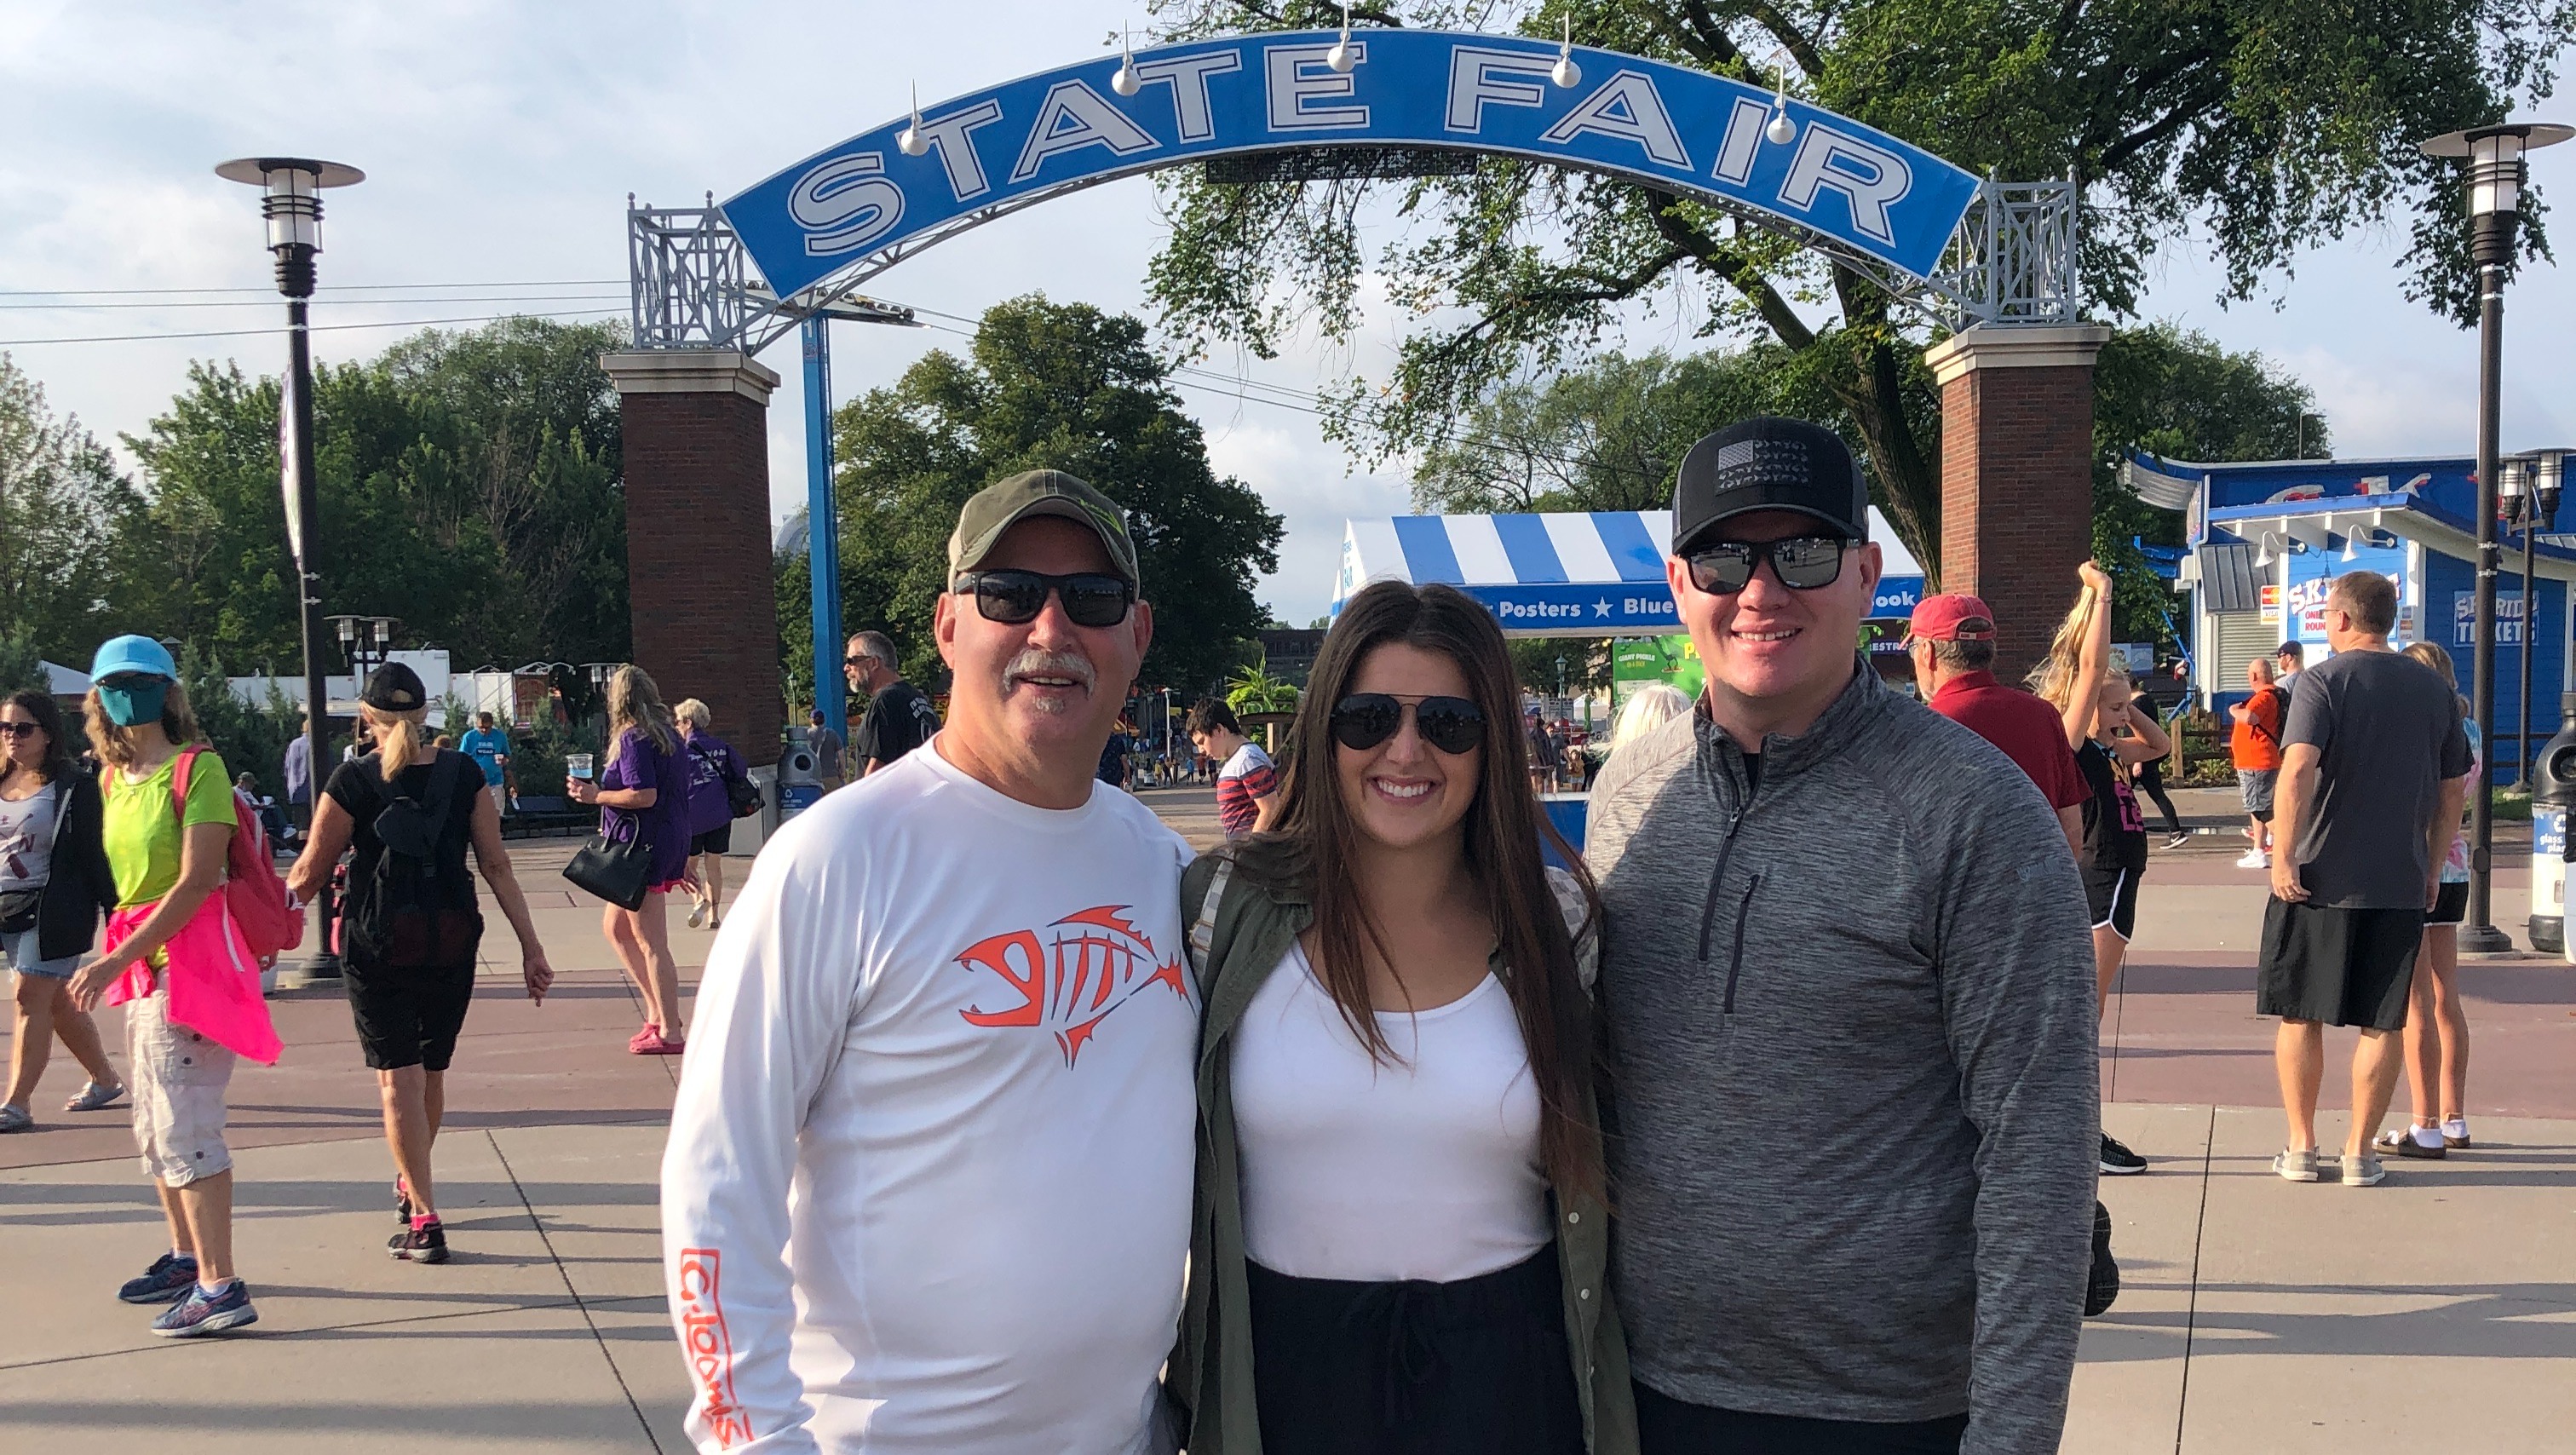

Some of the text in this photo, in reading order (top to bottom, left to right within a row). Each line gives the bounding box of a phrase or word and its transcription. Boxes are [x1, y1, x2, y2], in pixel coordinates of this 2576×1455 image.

[787, 41, 1913, 257] STATE FAIR
[804, 319, 813, 338] 1
[1499, 600, 1581, 618] Posters
[1624, 597, 1674, 614] Blue
[1872, 590, 1916, 607] ook
